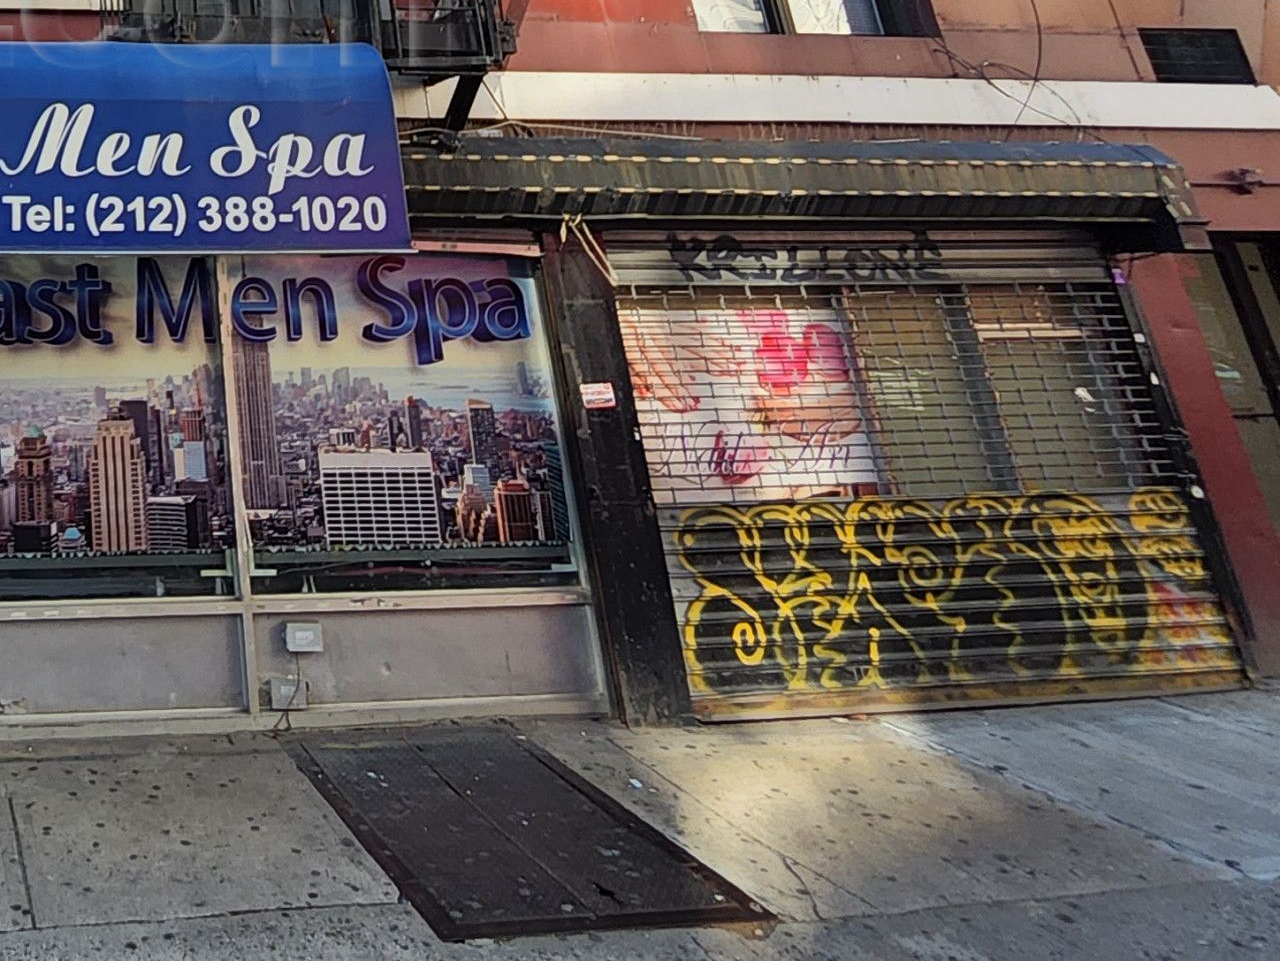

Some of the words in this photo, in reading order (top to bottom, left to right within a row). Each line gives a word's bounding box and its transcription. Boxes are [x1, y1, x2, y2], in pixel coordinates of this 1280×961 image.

[209, 104, 375, 196] Spa
[2, 195, 76, 233] Tel:
[85, 192, 187, 237] (212)
[197, 195, 387, 232] 388-1020
[135, 255, 339, 342] Men
[357, 255, 532, 366] Spa
